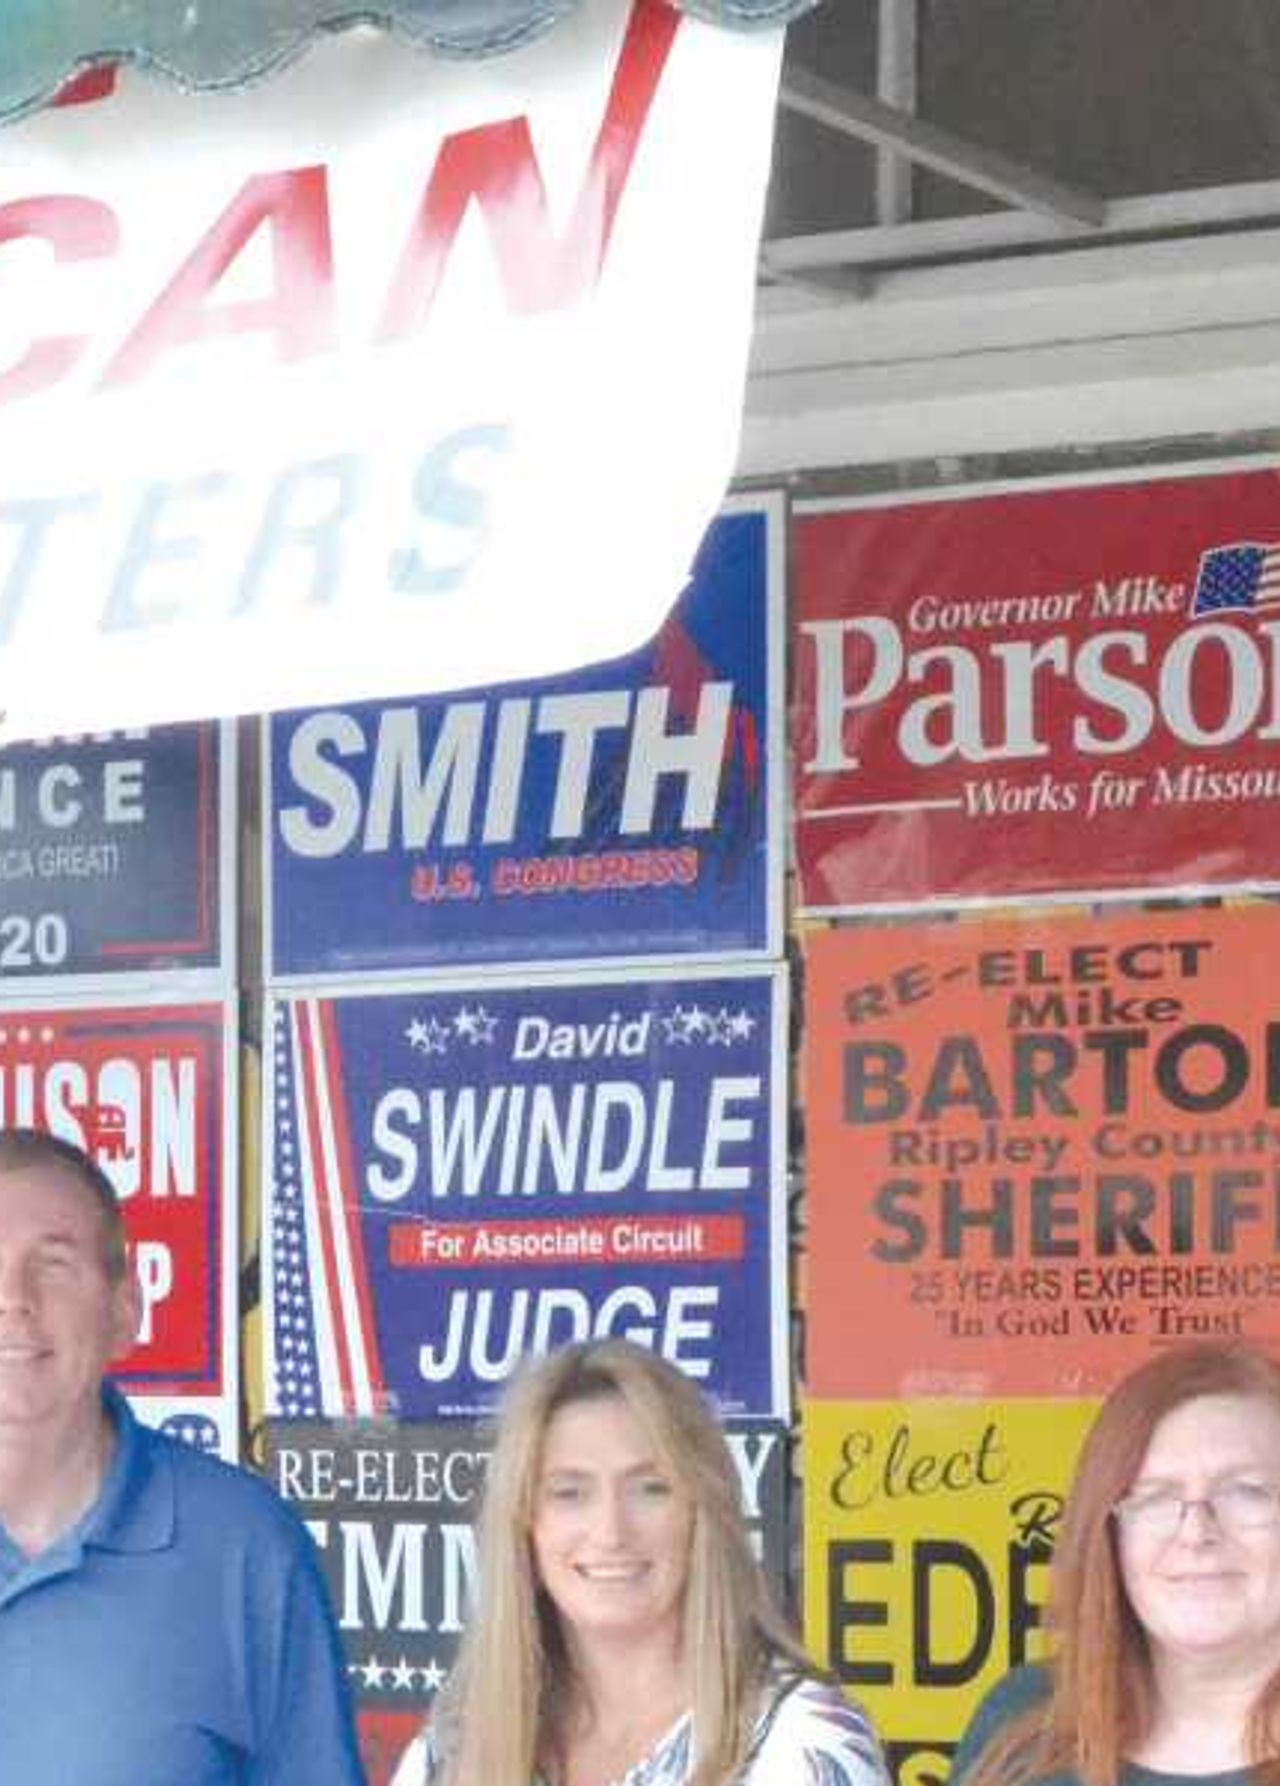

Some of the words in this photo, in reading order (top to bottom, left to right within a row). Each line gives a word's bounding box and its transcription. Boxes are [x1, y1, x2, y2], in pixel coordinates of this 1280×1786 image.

[910, 588, 1083, 633] Governor
[1090, 577, 1185, 619] Mike
[278, 681, 734, 858] SMITH
[963, 777, 1077, 818] Works
[1086, 772, 1145, 818] for
[492, 847, 698, 895] CONGRESS
[842, 940, 1212, 1026] RE-ELECT
[1007, 990, 1183, 1029] Mike
[511, 1012, 651, 1061] David
[366, 1075, 761, 1200] SWINDLE
[889, 1123, 1070, 1173] Ripley
[421, 1228, 466, 1258] For
[472, 1224, 604, 1256] Associate
[612, 1222, 704, 1253] Circuit
[957, 1267, 1063, 1302] YEARS
[420, 1285, 720, 1382] JUDGE
[996, 1306, 1071, 1337] God
[1084, 1306, 1136, 1336] We
[830, 1422, 1008, 1509] Elect
